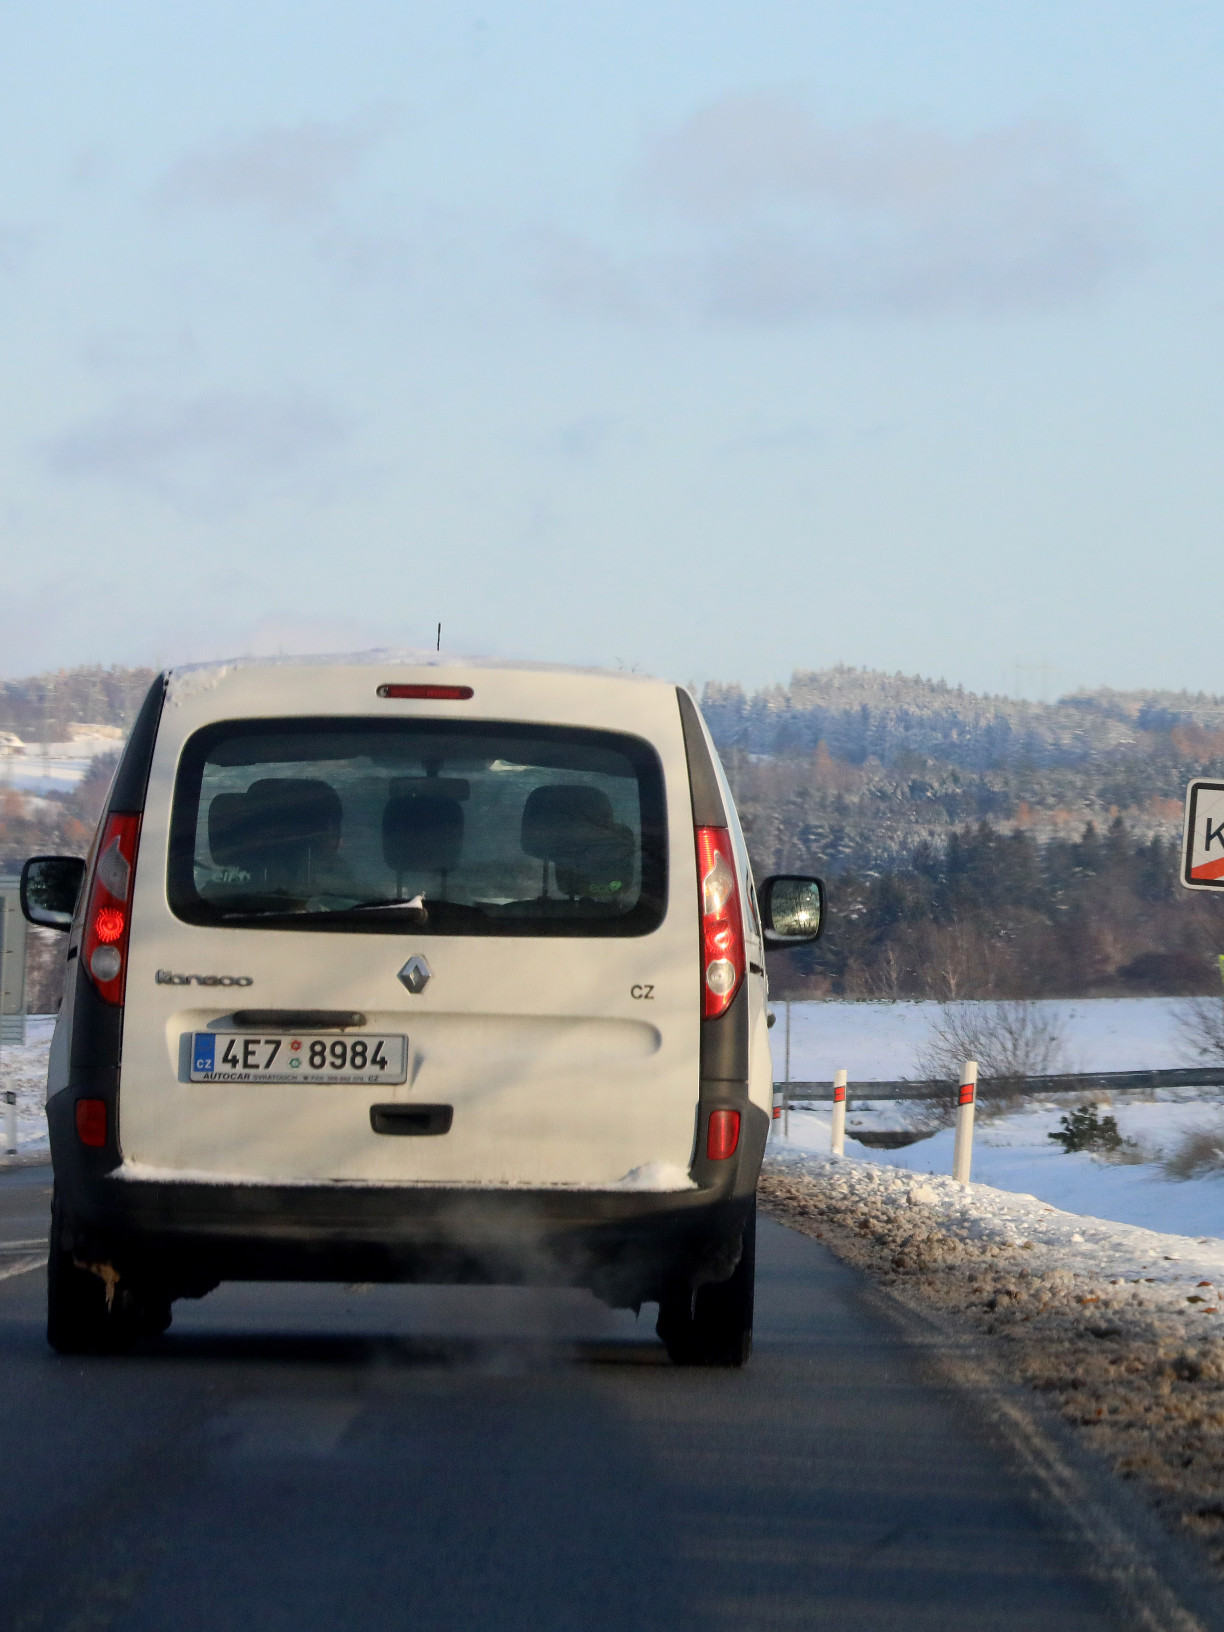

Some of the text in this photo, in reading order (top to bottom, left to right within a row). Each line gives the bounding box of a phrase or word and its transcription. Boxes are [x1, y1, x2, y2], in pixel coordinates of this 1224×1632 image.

[630, 984, 655, 1001] CZ
[221, 1039, 388, 1071] 4E7 8984
[196, 1058, 212, 1069] CZ
[203, 1072, 251, 1081] AUTOCAR
